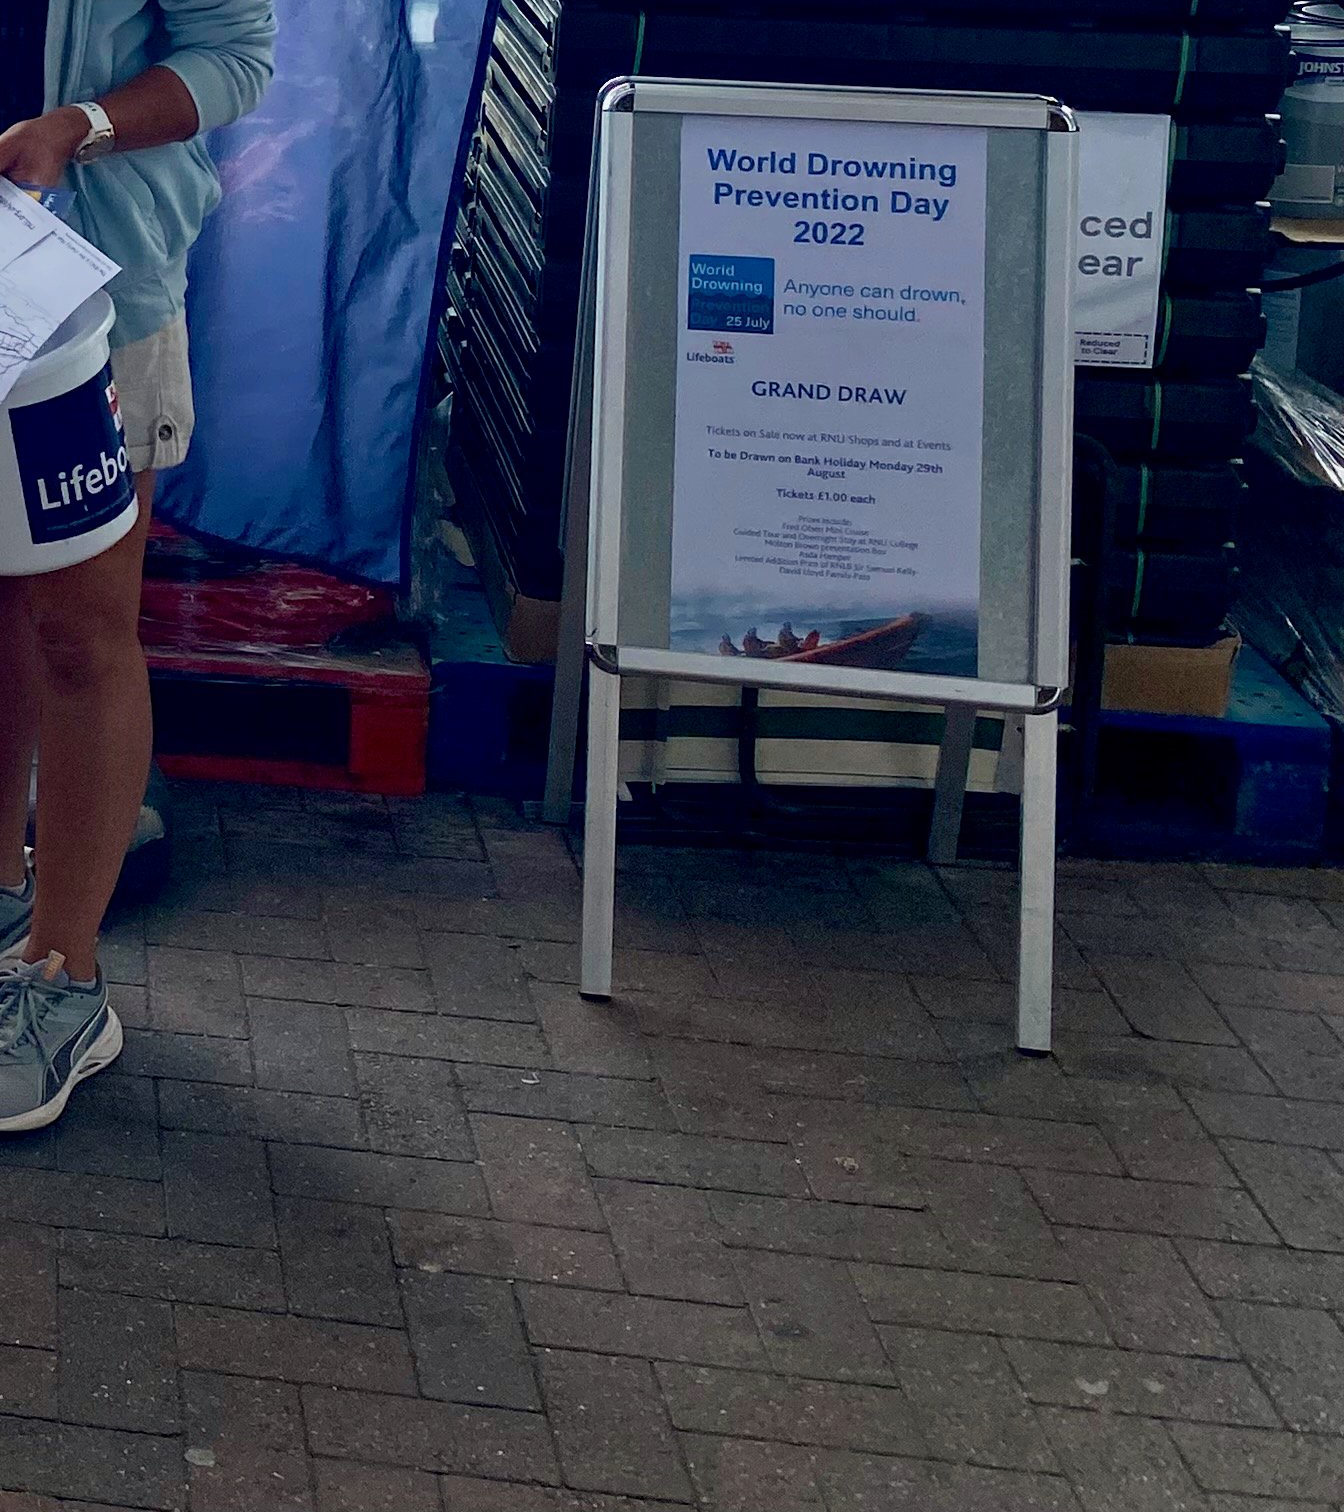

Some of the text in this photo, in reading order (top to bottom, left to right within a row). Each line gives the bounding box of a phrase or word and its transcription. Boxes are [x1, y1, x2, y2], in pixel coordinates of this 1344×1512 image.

[707, 148, 957, 187] World Drowning
[713, 182, 950, 221] Prevention Day
[793, 220, 865, 246] 2022
[692, 262, 735, 277] World
[692, 277, 763, 295] Drowning
[783, 278, 966, 305] Anyone can drown,
[691, 298, 769, 313] Prevention
[783, 303, 807, 315] no
[812, 305, 847, 318] one
[726, 315, 770, 331] 25 July
[1079, 338, 1121, 348] Reduced
[1081, 347, 1119, 356] to Clear
[687, 352, 734, 364] Lifeboats
[751, 380, 908, 406] GRAND DRAW
[706, 425, 952, 451] Tickets on Sale now at RNLI Shops and at Events
[708, 448, 944, 474] To be Drawn on Bank Holiday Monday 29th
[37, 446, 128, 510] Lifebo
[807, 467, 846, 480] August
[776, 488, 876, 505] Tickets £1.00 each
